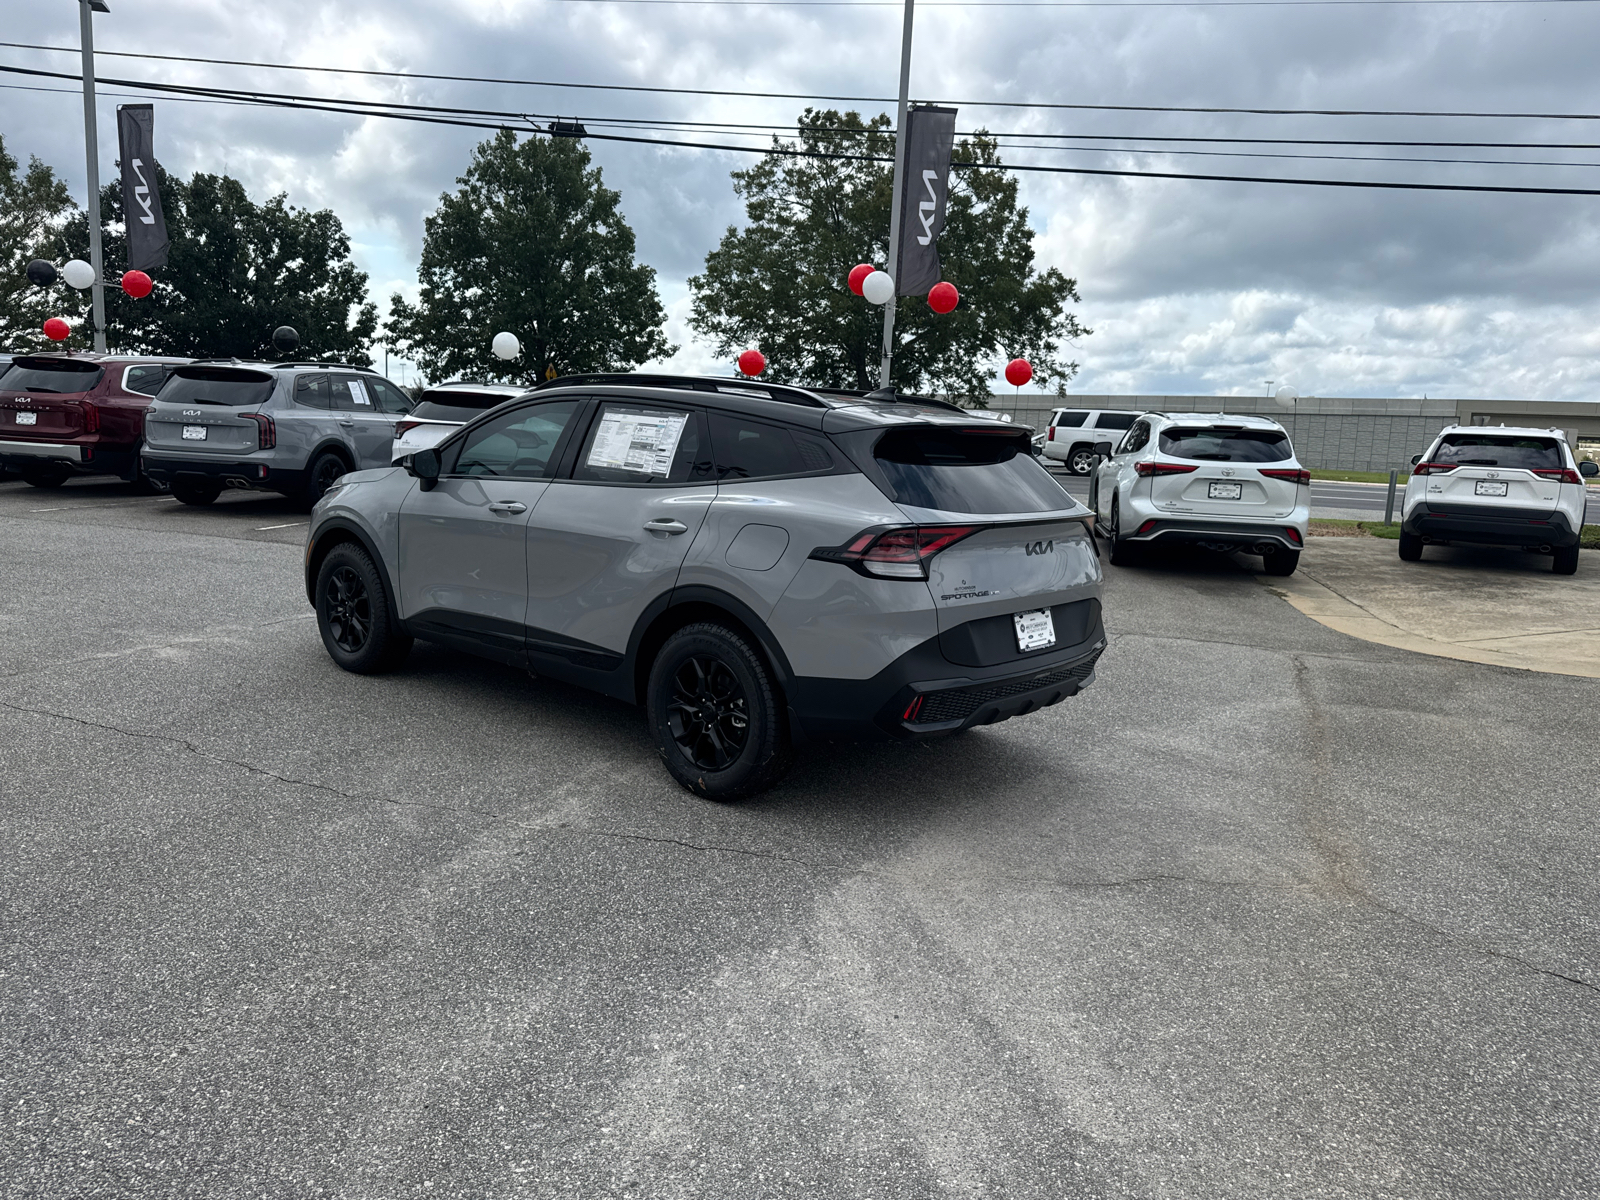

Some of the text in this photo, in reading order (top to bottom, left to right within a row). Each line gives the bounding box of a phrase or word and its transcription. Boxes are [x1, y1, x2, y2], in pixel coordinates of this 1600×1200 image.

[132, 158, 155, 225] KIA
[916, 169, 939, 246] KIA
[1025, 540, 1054, 557] KIA
[941, 590, 990, 601] SPORTAGE
